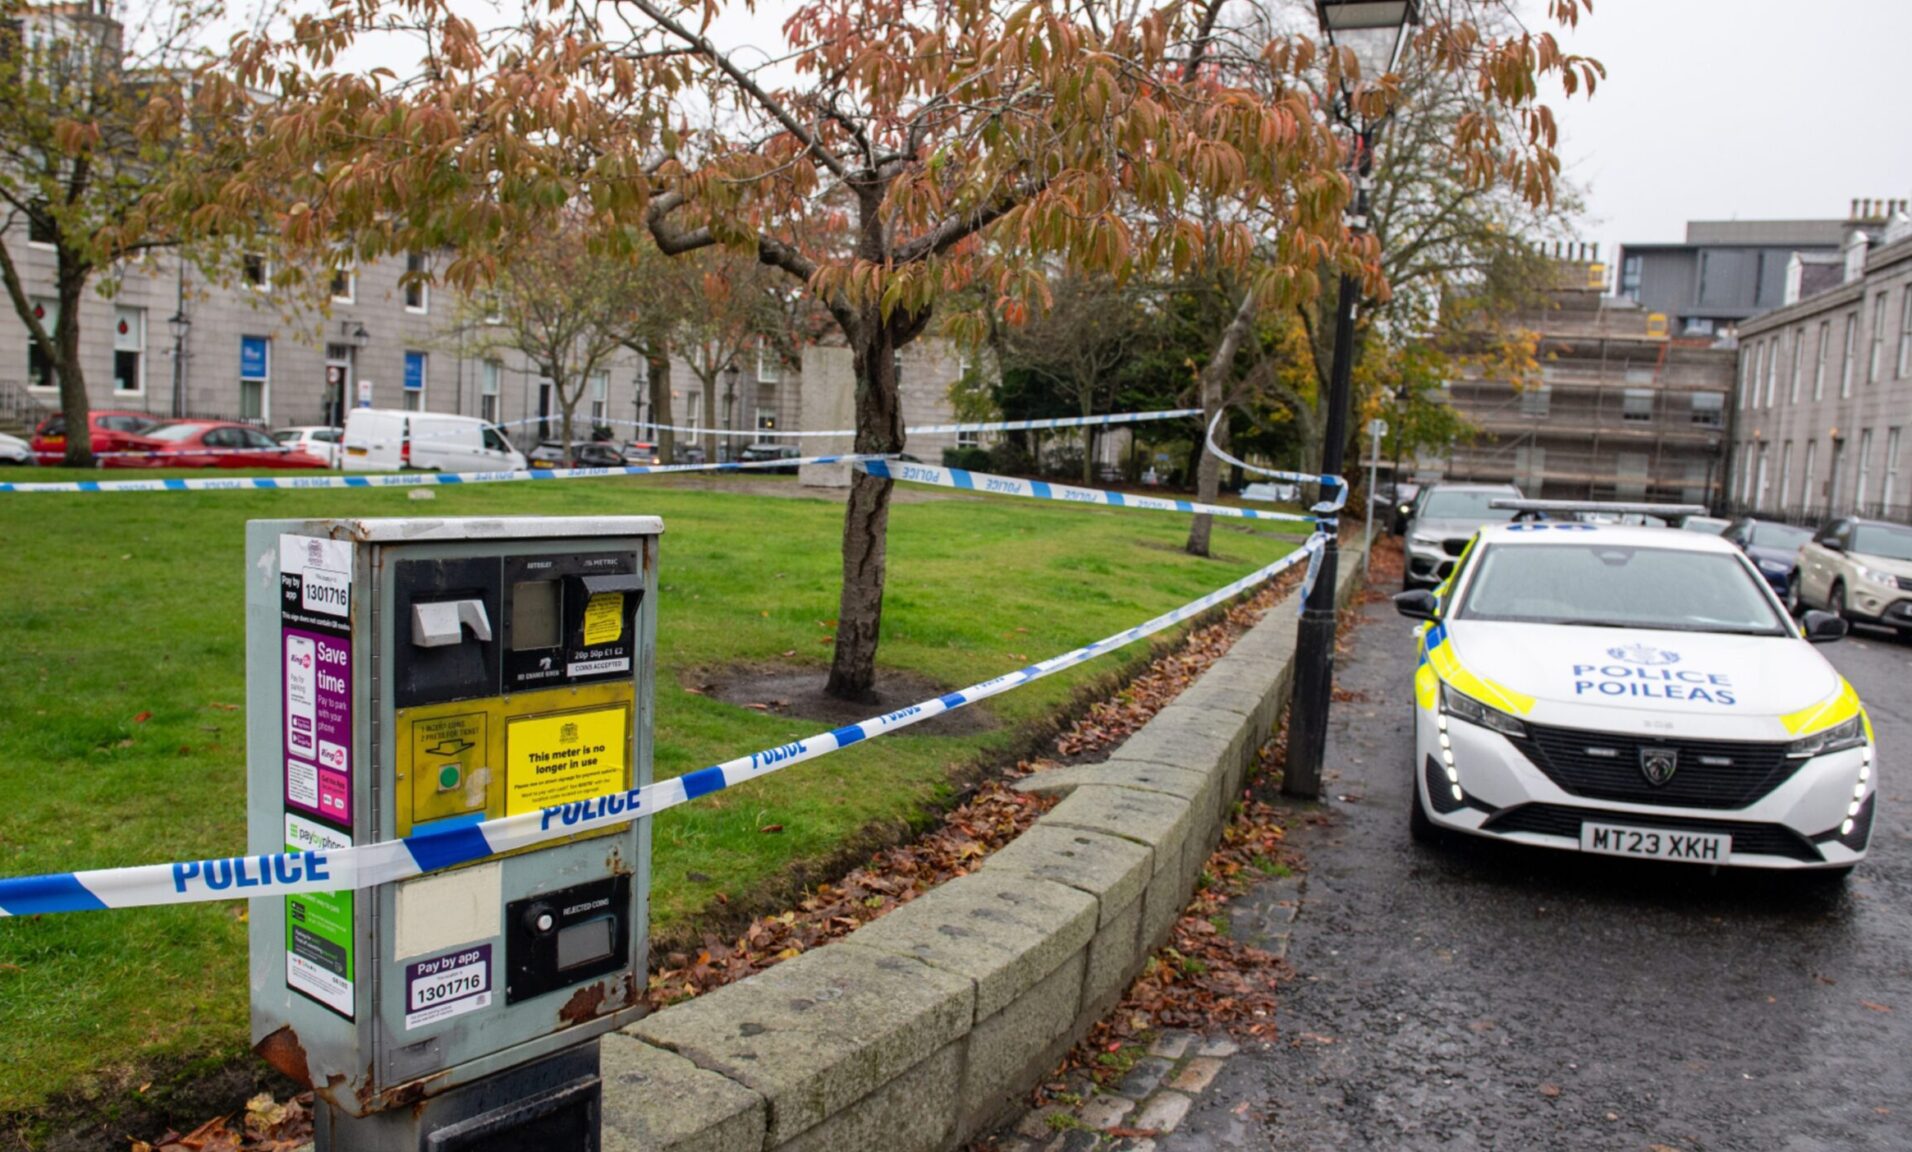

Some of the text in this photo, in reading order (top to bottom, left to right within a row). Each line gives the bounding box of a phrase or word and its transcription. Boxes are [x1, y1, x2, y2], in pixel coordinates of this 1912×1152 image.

[903, 466, 940, 484] POLICE
[987, 478, 1021, 494] POLICE
[282, 575, 300, 589] Pay by
[306, 584, 347, 606] 1301716
[317, 641, 347, 666] Save
[575, 647, 623, 660] 20p 50p £1 £2
[575, 660, 623, 672] COINS ACCEPTED
[1573, 665, 1733, 687] POLICE
[317, 669, 345, 694] time
[318, 695, 328, 707] Pay
[328, 698, 334, 707] to
[335, 700, 347, 711] park
[1575, 681, 1737, 706] POILEAS
[318, 709, 330, 718] with
[318, 721, 335, 734] phone
[529, 744, 605, 763] This meter is no
[536, 757, 597, 775] longer in use
[541, 788, 640, 831] POLICE
[299, 828, 345, 849] paybyphon
[1592, 827, 1719, 860] MT23 XKH
[172, 851, 330, 893] POLICE
[563, 897, 609, 916] REJECTED COINS
[417, 961, 439, 976] Pay
[441, 956, 457, 969] by
[458, 951, 480, 965] app
[418, 974, 480, 1004] 1301716
